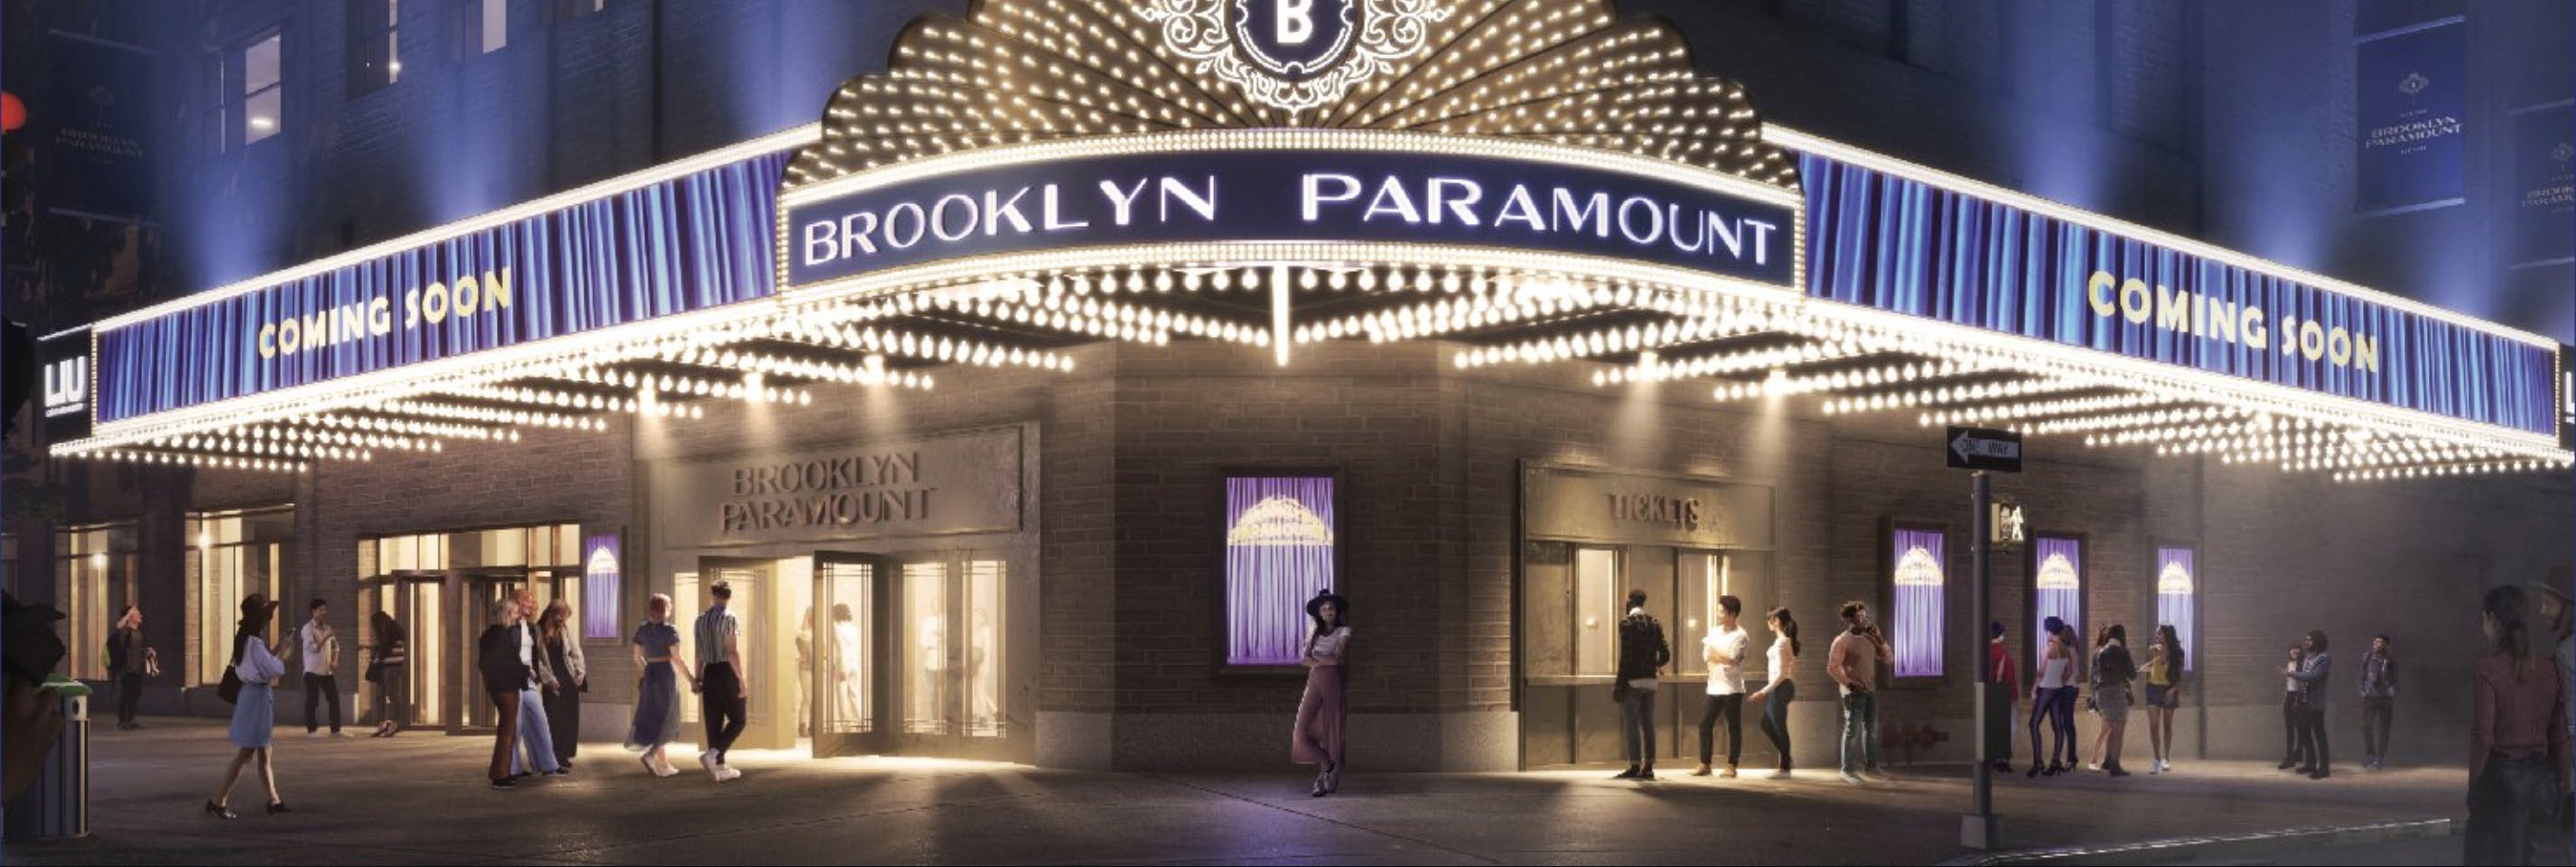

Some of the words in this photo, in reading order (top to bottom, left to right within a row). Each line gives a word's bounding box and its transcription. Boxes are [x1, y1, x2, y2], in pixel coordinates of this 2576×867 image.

[1277, 0, 1313, 43] B
[2366, 123, 2463, 149] PARAMOUNT
[2371, 117, 2456, 138] BROOKLYN
[804, 174, 1216, 266] BROOKLYN
[1301, 172, 1777, 265] PARAMOUNT
[259, 296, 391, 359] COMING
[405, 266, 511, 331] SOON
[2088, 270, 2267, 350] COMING
[2282, 313, 2378, 373] SOON
[44, 355, 86, 407] LIU
[1987, 441, 2010, 456] WAY
[734, 451, 920, 496] BROOKLYN
[720, 486, 940, 531] PARAMOUNT
[1605, 492, 1701, 530] TICKETS
